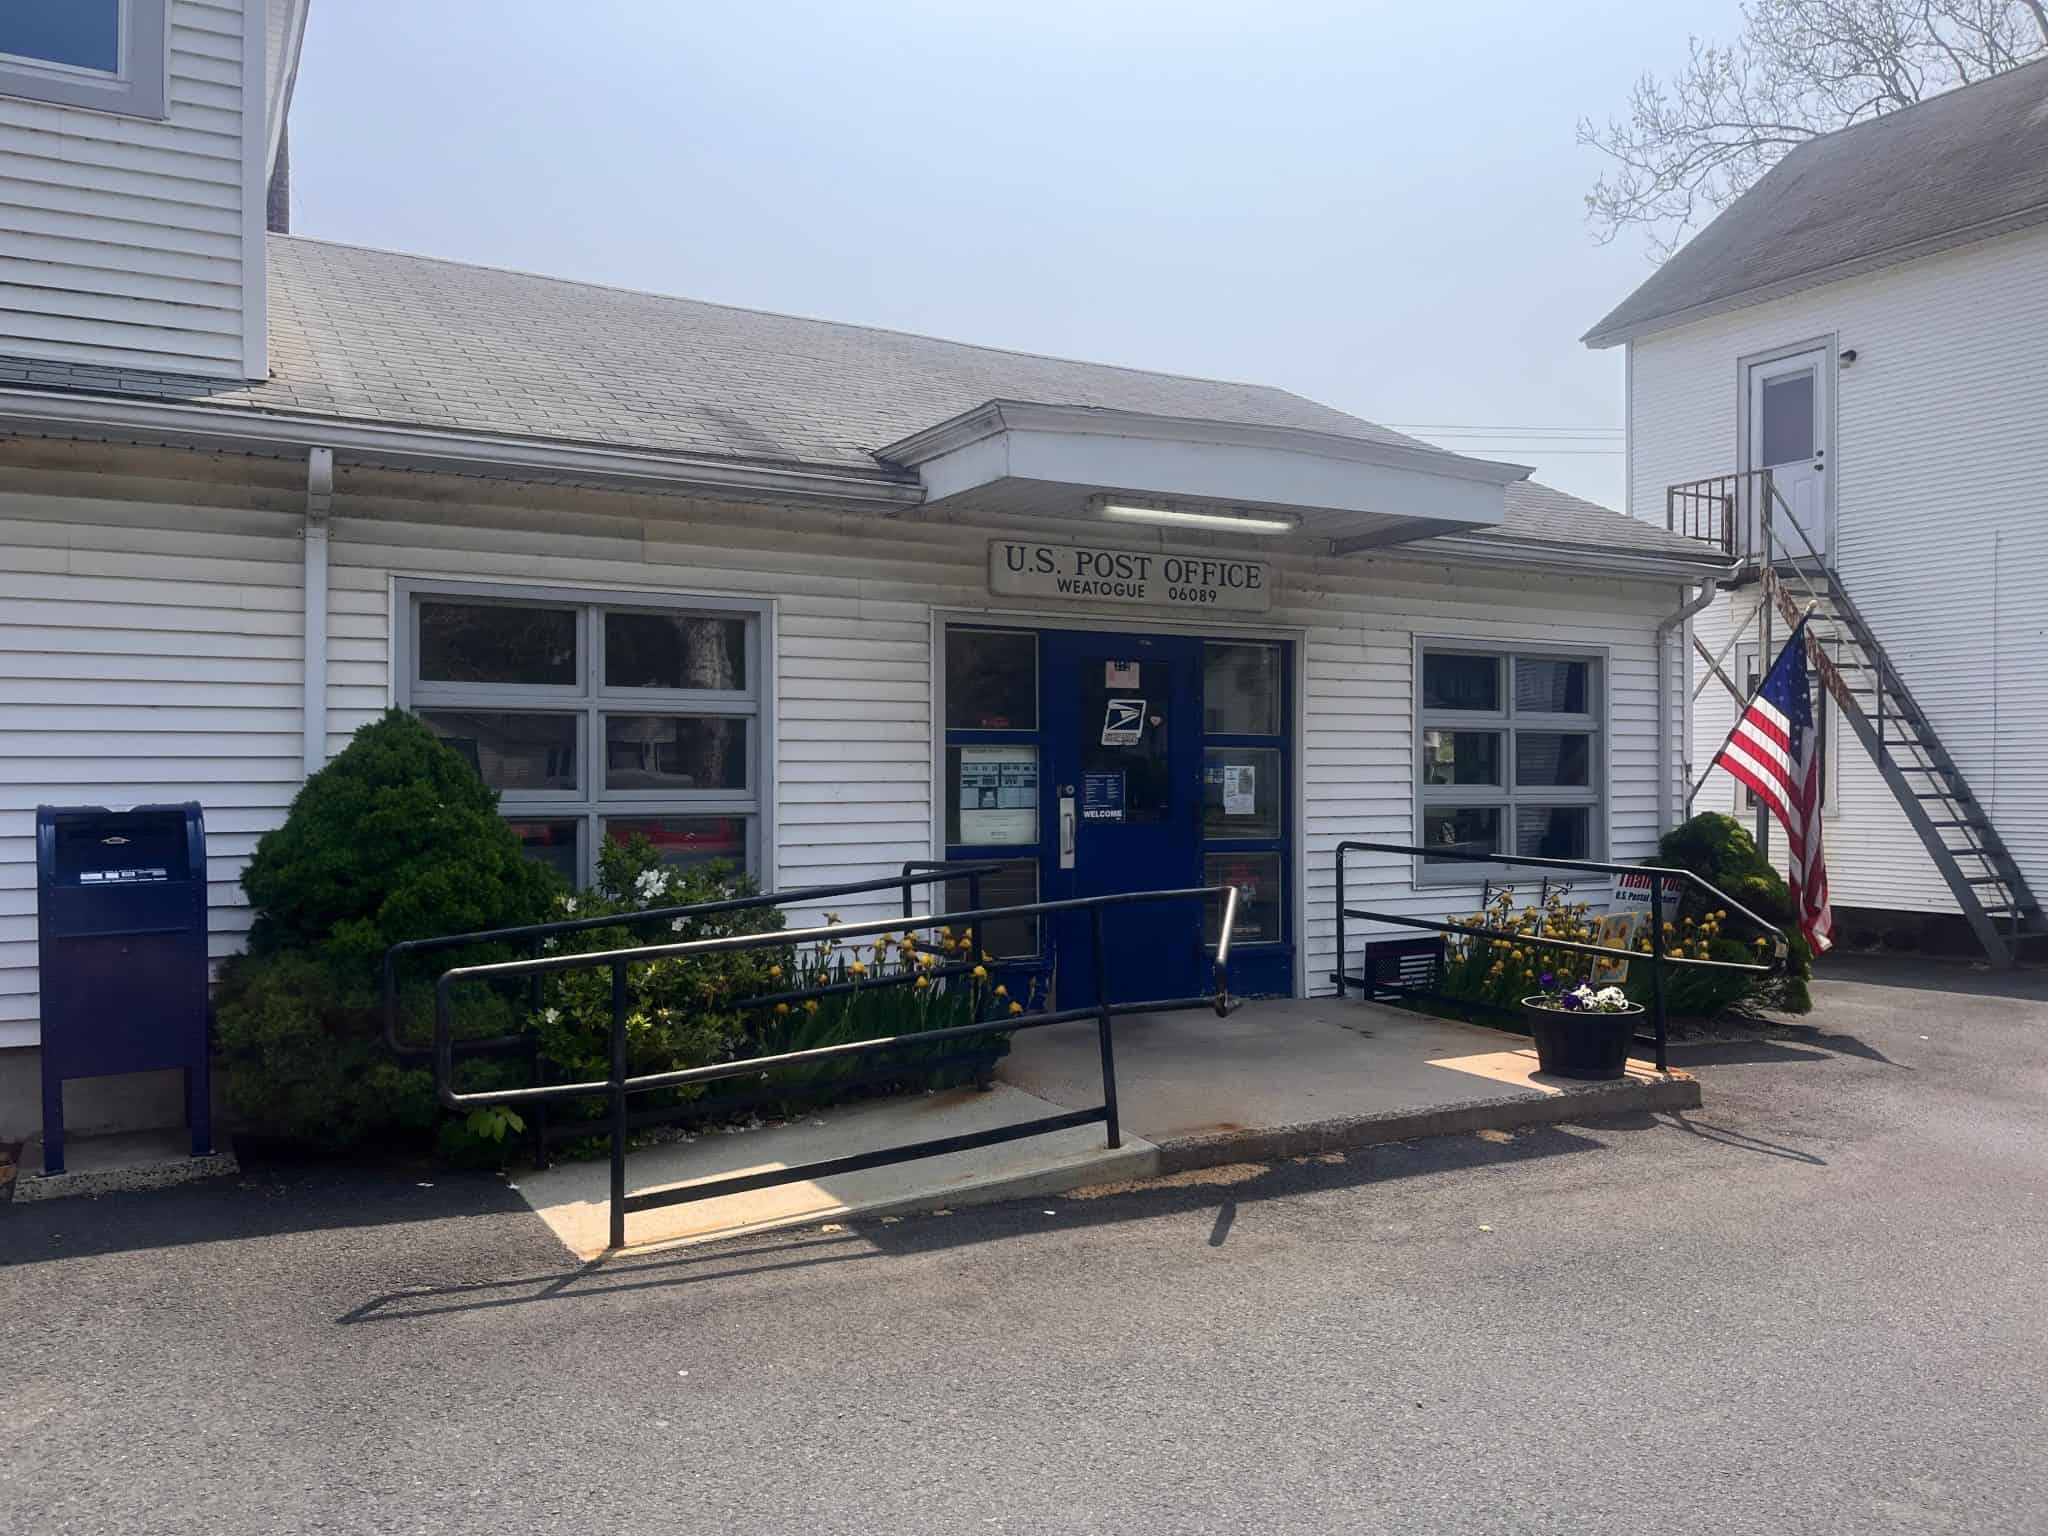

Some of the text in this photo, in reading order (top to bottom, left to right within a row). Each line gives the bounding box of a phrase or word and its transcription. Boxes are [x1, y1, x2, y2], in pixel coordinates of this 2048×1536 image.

[1005, 545, 1262, 589] U.S. POST OFFICE
[1057, 577, 1217, 603] WEATOGUE 06089
[1083, 809, 1122, 818] WELCOME
[1619, 873, 1651, 889] Than
